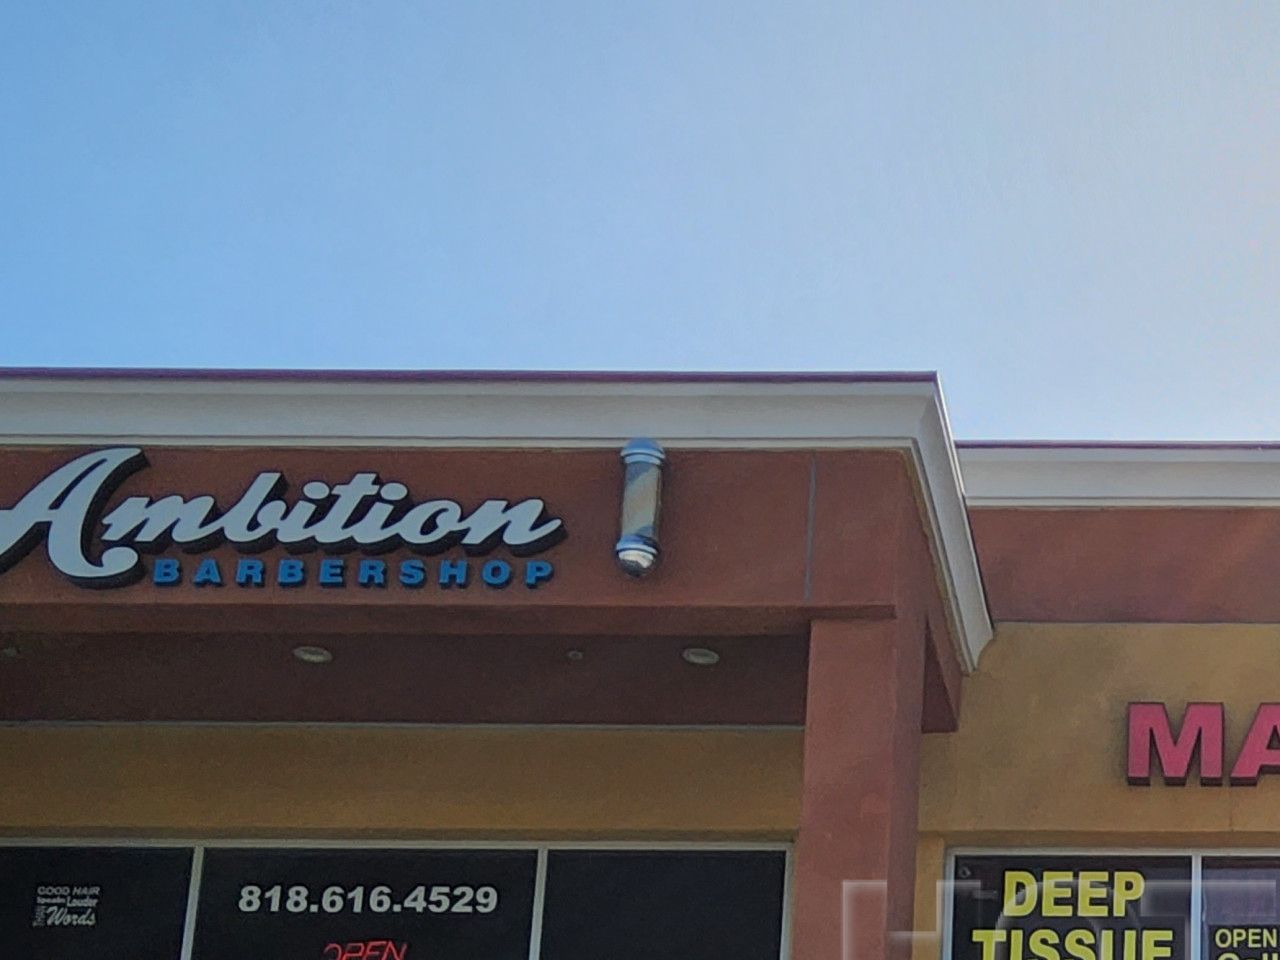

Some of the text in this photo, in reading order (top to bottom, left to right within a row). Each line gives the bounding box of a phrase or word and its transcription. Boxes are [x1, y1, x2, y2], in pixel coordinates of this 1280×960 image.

[0, 446, 563, 578] Ambition
[153, 558, 554, 586] BARBERSHOP
[72, 886, 101, 896] HAIR
[238, 885, 499, 913] 818.616.4529
[1003, 870, 1145, 917] DEEP
[46, 905, 97, 926] Words
[1214, 928, 1277, 948] OPEN
